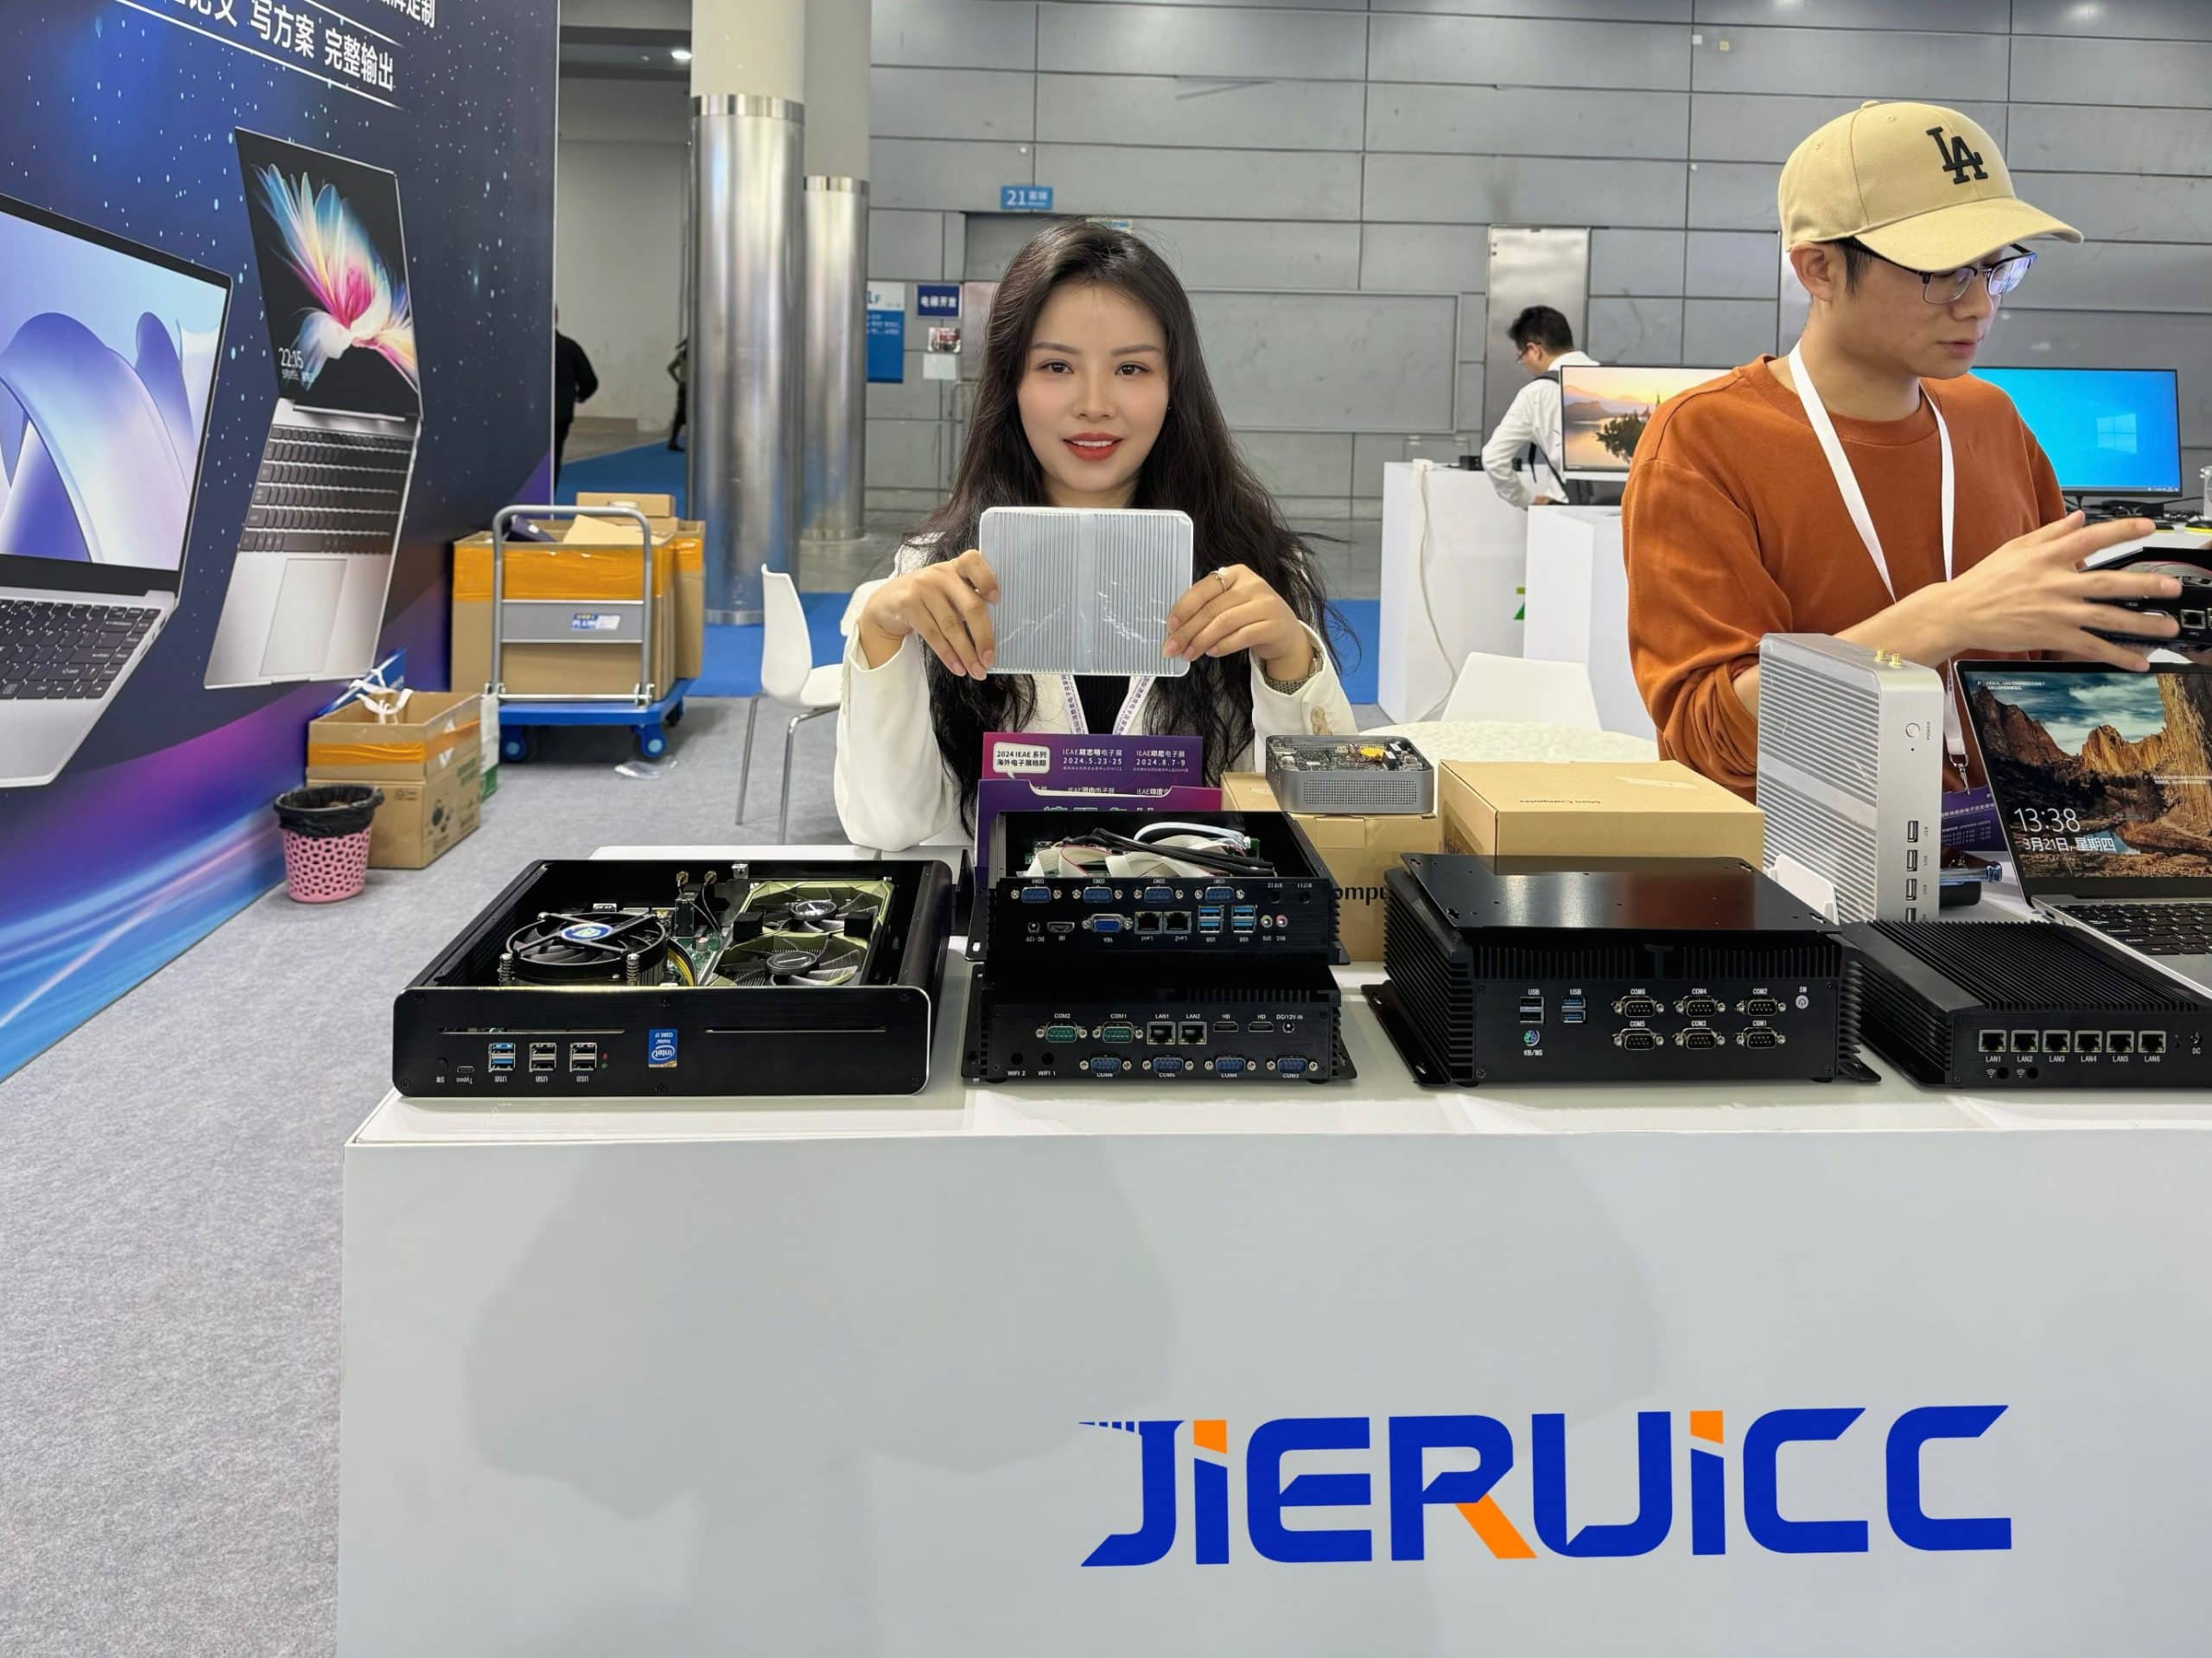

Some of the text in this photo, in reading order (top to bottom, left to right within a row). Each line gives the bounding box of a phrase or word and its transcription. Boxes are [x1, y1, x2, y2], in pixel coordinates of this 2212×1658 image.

[250, 0, 315, 59] 写方案
[324, 28, 393, 92] 完整输出
[1925, 126, 1989, 185] LA
[1007, 189, 1026, 206] 21
[2014, 808, 2081, 832] 13:38
[2075, 837, 2117, 852] 星期四
